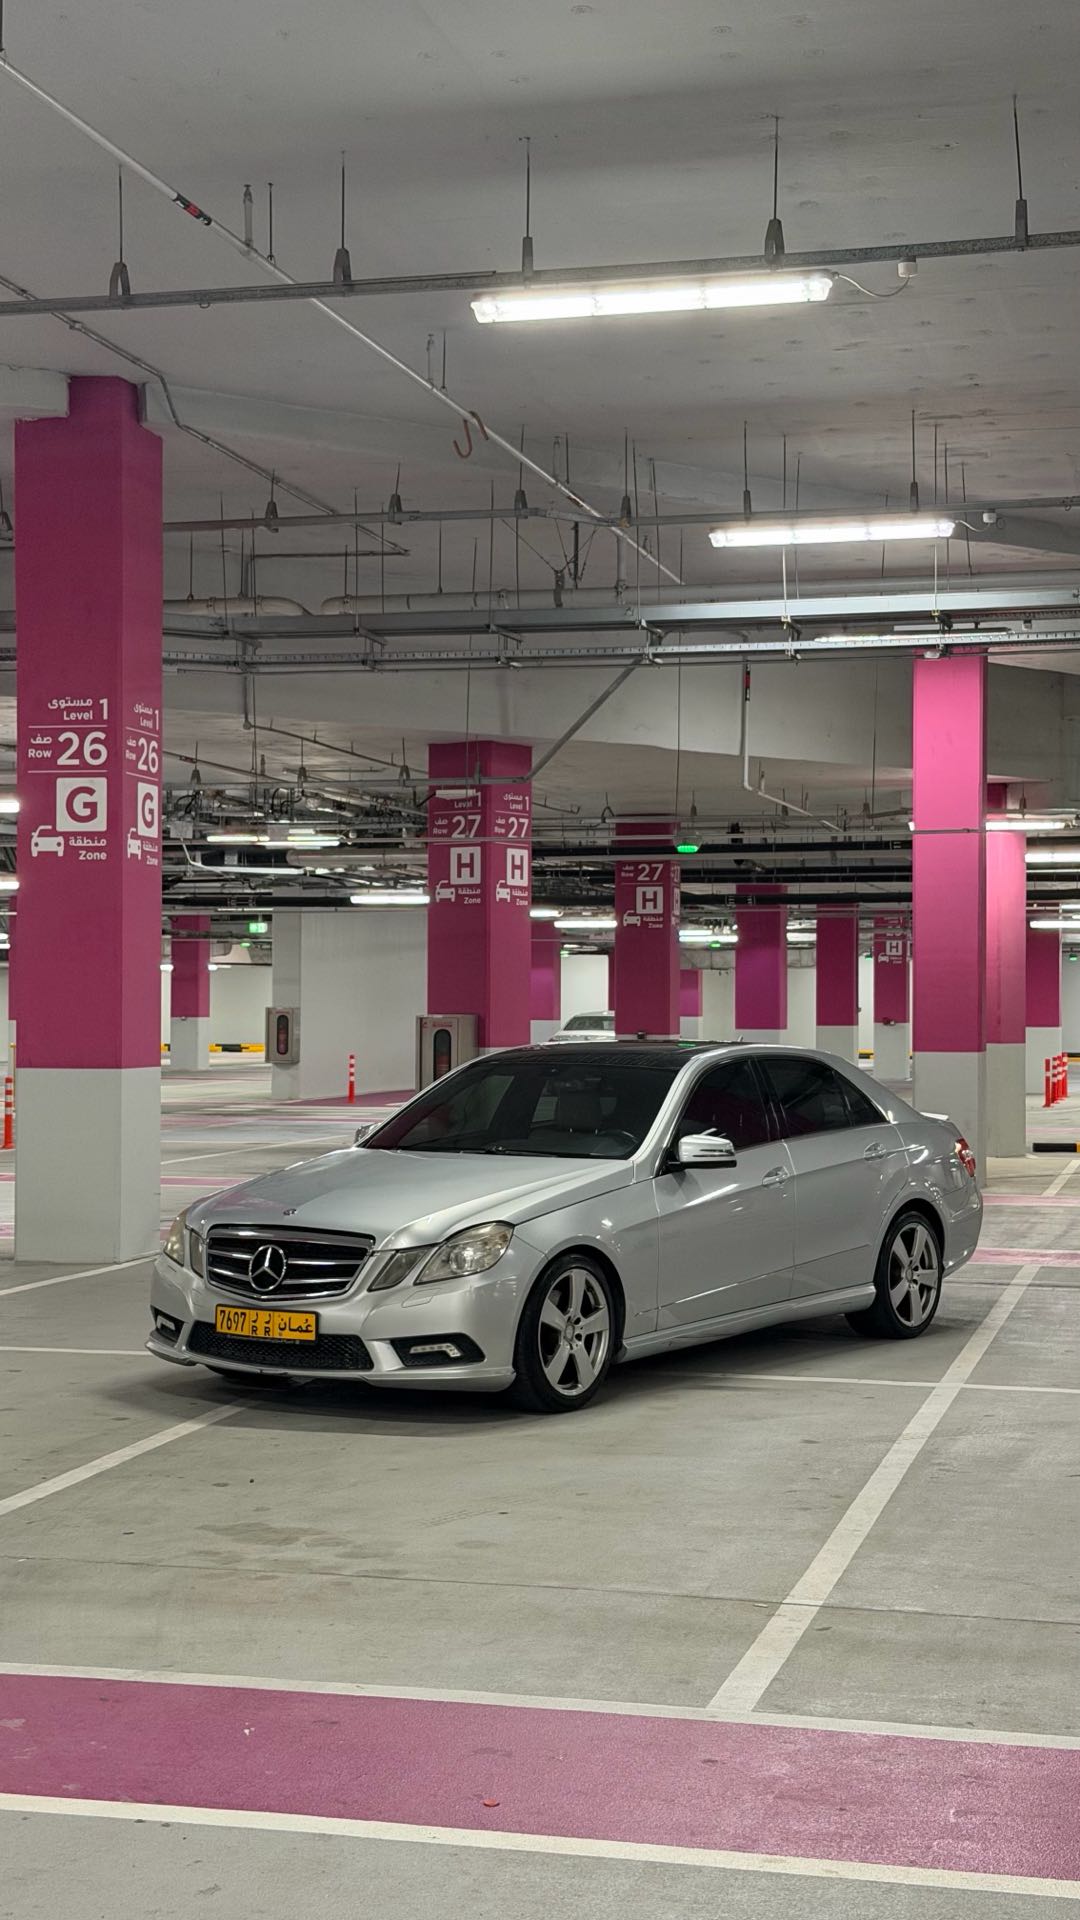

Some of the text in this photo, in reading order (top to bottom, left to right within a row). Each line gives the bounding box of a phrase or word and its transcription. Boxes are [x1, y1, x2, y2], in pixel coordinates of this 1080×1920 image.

[48, 697, 93, 710] مستوى
[99, 698, 109, 720] 1
[63, 710, 93, 720] Level
[154, 709, 159, 731] 1
[30, 733, 52, 745] صف
[57, 731, 108, 766] 26
[28, 748, 52, 759] Row
[137, 737, 159, 774] 26
[65, 786, 98, 824] G
[141, 791, 154, 830] G
[451, 814, 482, 838] 27
[507, 816, 529, 838] 27
[69, 836, 107, 847] منطقة
[78, 850, 107, 861] Zone
[456, 852, 475, 879] H
[511, 854, 524, 881] H
[637, 863, 664, 881] 27
[463, 897, 481, 905] Zone
[641, 890, 658, 910] H
[889, 941, 899, 953] H
[219, 1309, 247, 1332] 7697
